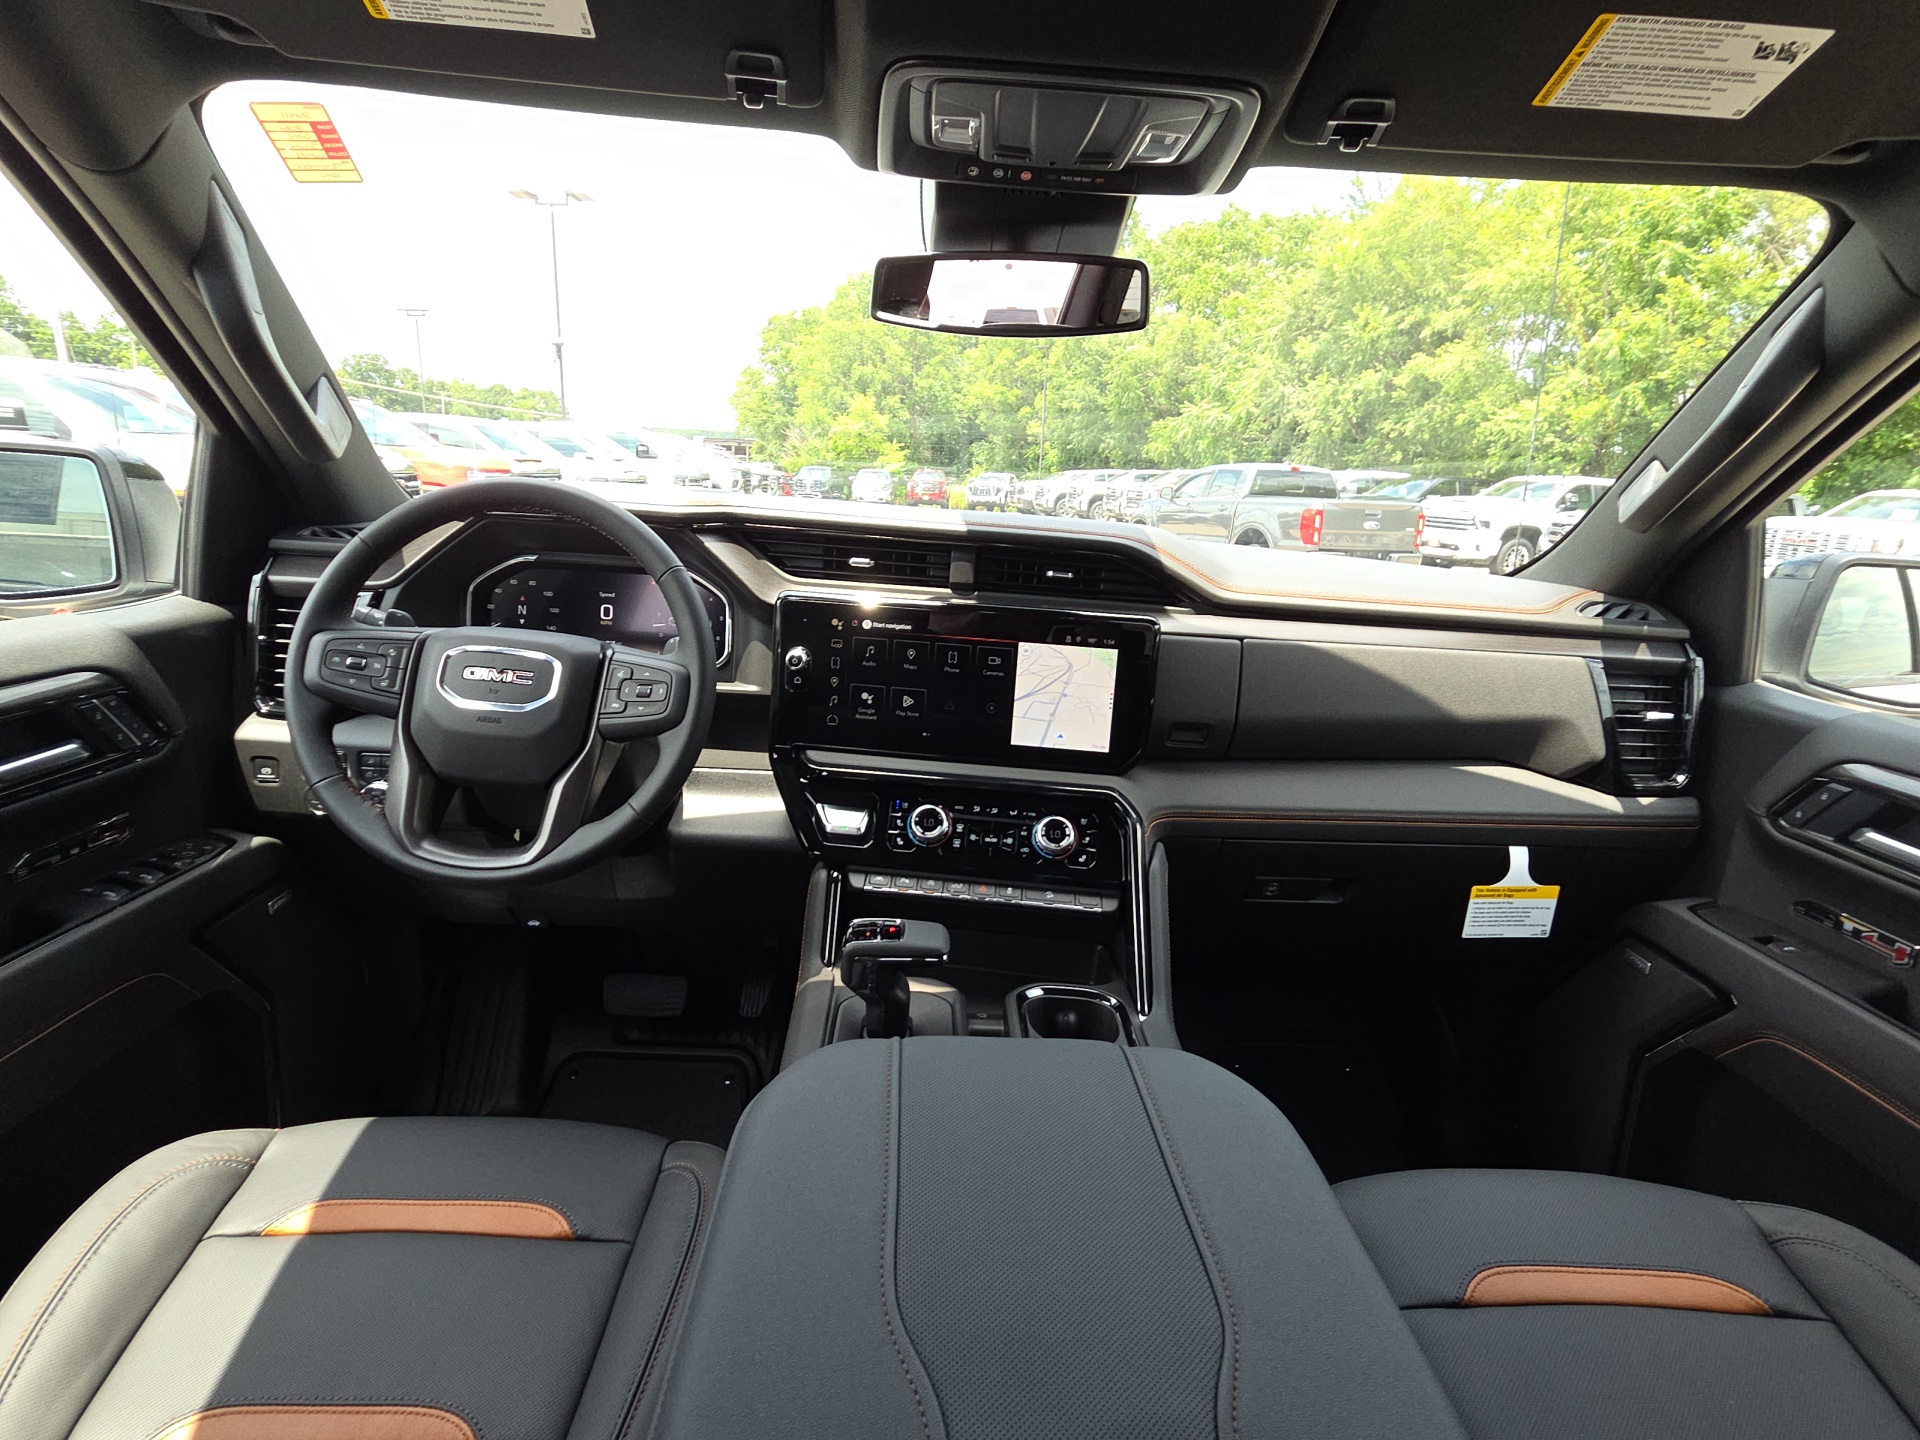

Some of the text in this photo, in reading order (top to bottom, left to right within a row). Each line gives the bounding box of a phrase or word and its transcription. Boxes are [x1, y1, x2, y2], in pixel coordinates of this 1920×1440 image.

[517, 604, 527, 615] N
[600, 604, 613, 620] 0
[885, 622, 912, 631] navigation
[462, 666, 535, 686] GMC
[982, 669, 1005, 677] Cameras
